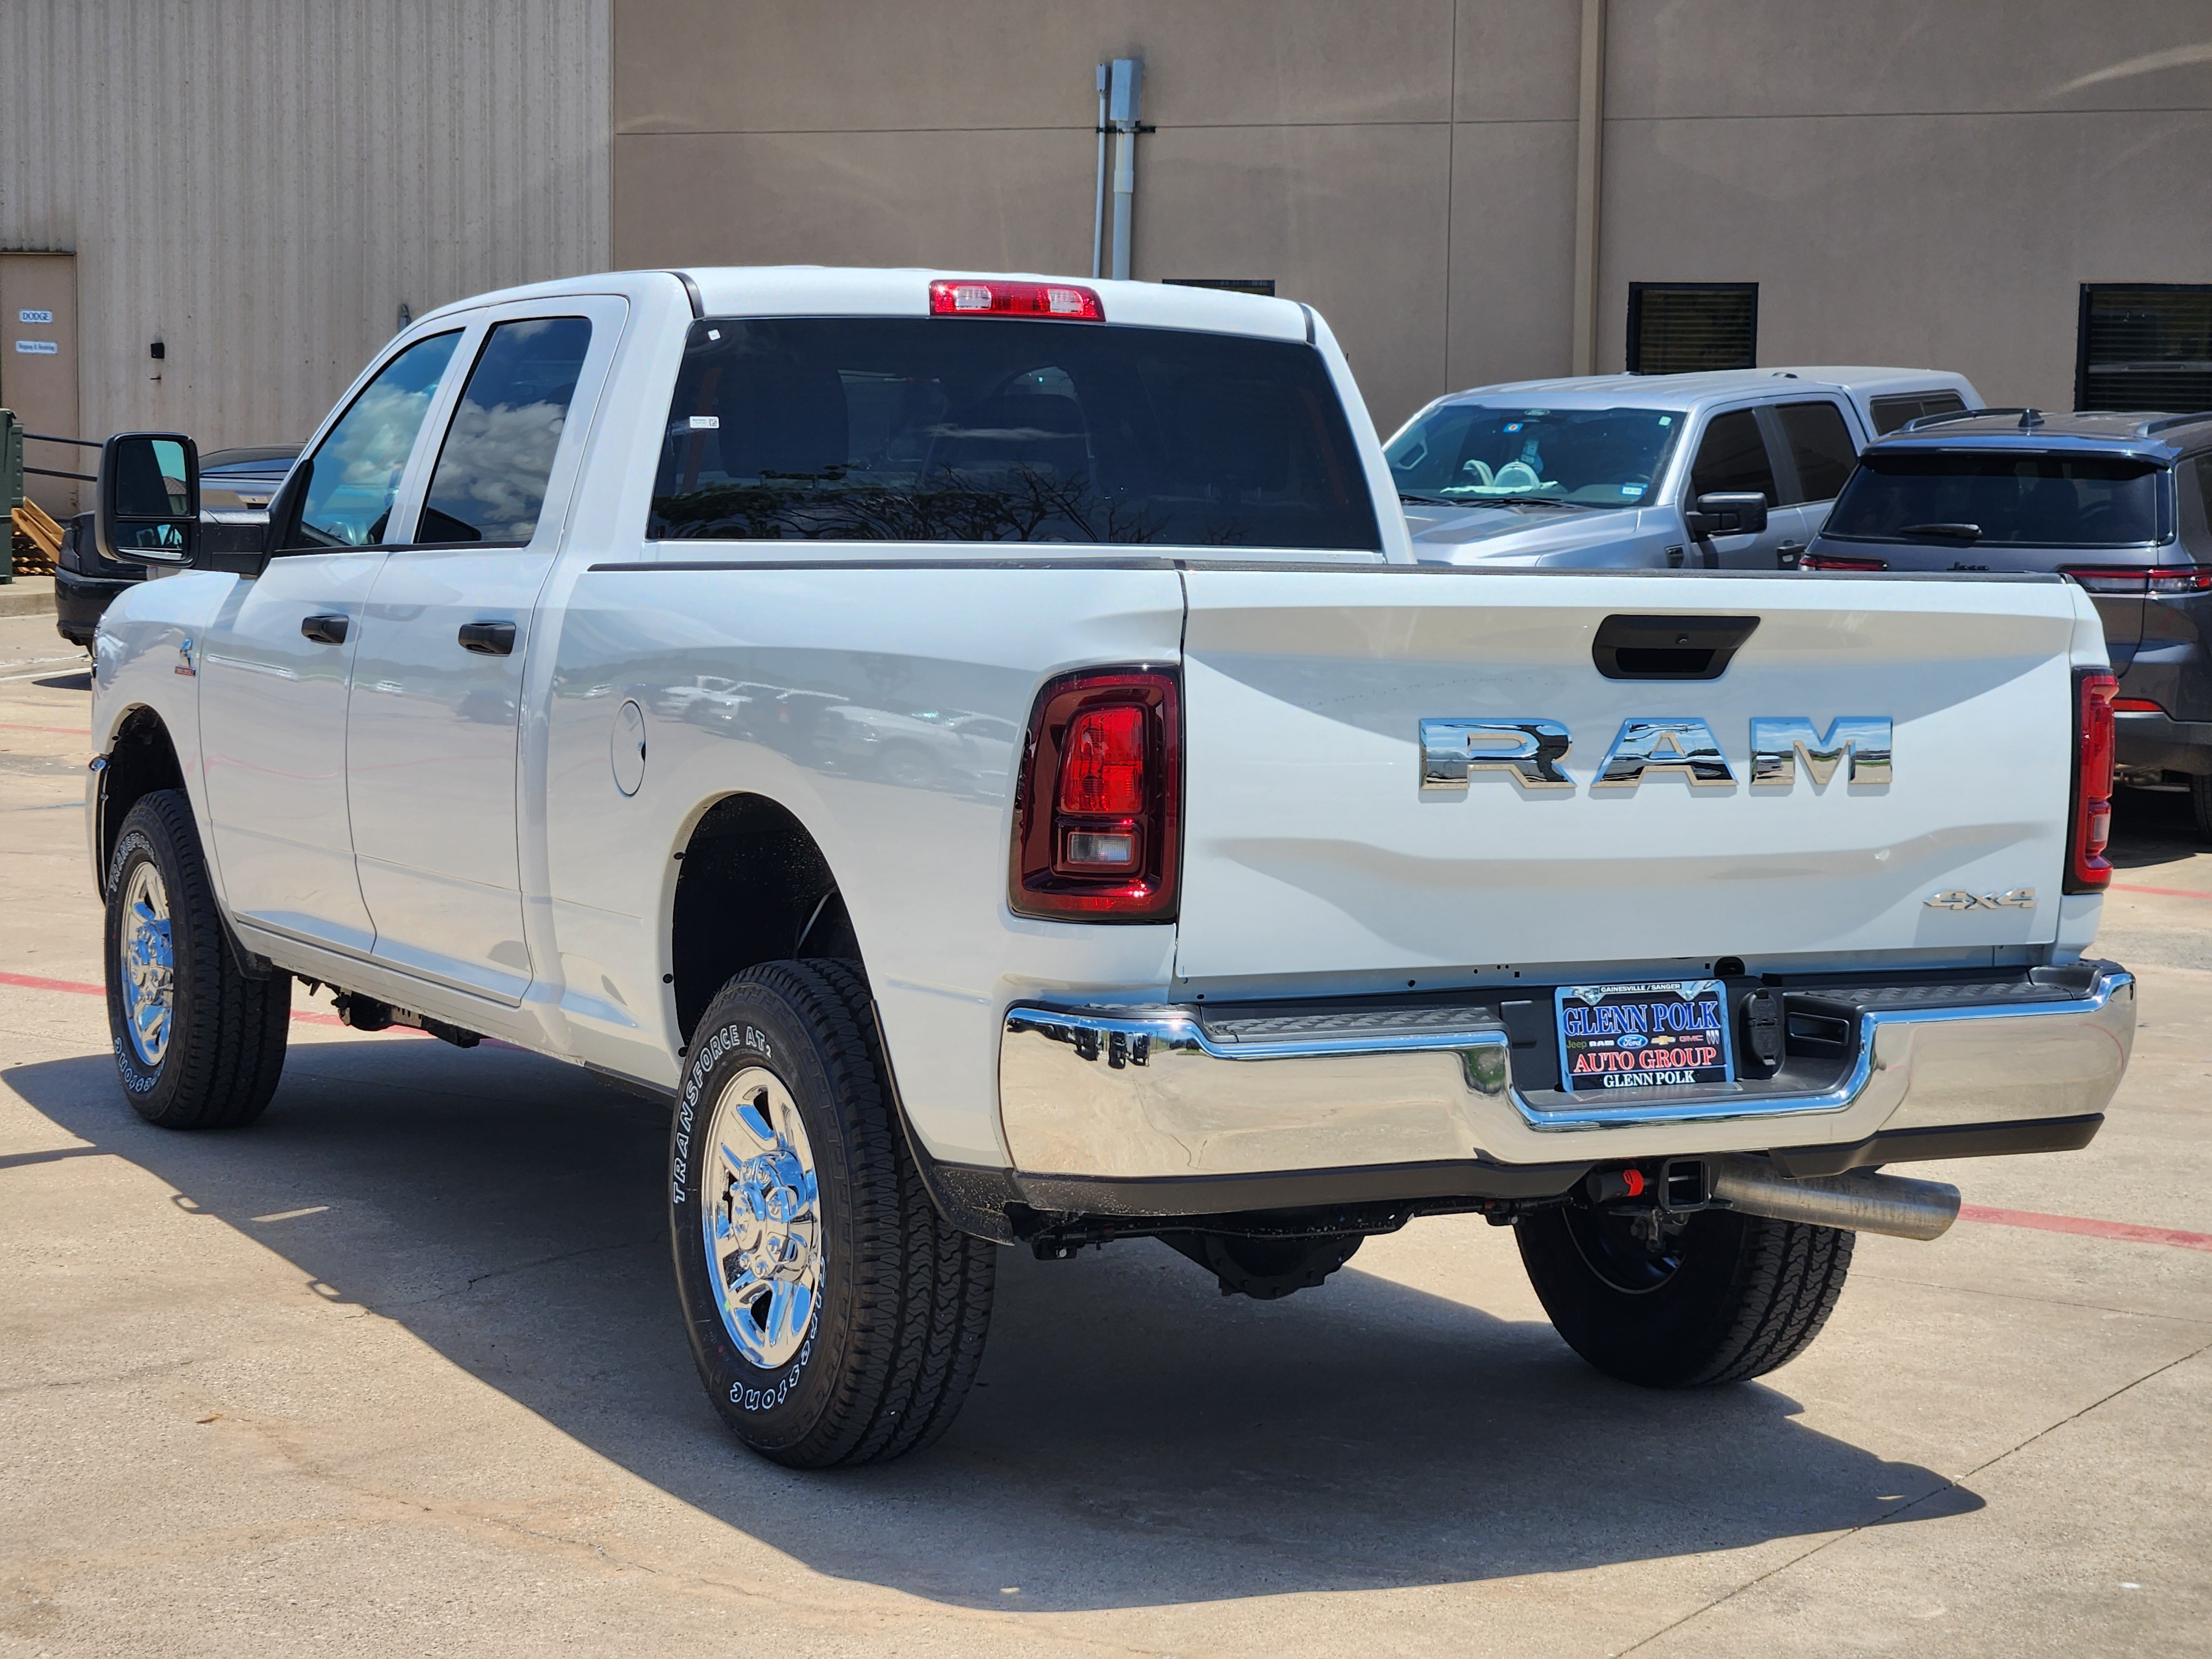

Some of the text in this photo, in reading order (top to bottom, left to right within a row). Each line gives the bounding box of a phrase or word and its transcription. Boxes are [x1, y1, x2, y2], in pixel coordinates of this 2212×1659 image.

[23, 312, 50, 321] DODGE
[1418, 716, 1893, 791] RAM
[1923, 887, 2039, 910] 4x4
[1600, 984, 1646, 993] GAINESVILLE
[1563, 1004, 1648, 1036] GLENN
[1651, 1000, 1721, 1031] POLK
[1567, 1040, 1587, 1050] Jeep
[1573, 1046, 1717, 1072] AUTO GROUP
[1603, 1070, 1696, 1088] GLENN POLK
[673, 1025, 740, 1204] TRANSFORCE
